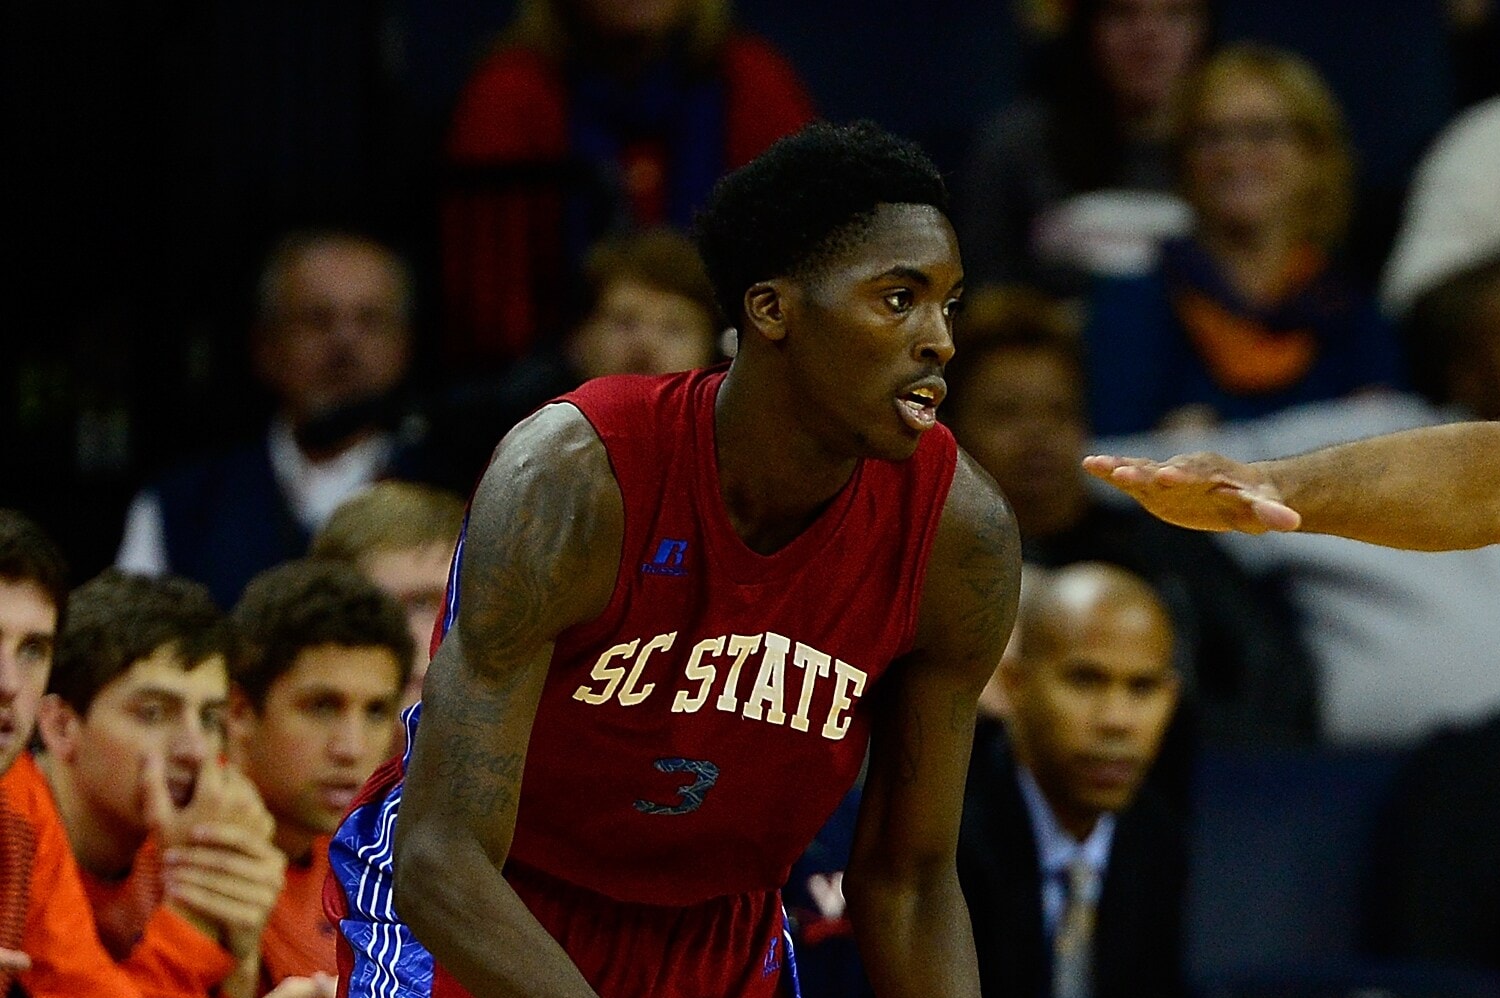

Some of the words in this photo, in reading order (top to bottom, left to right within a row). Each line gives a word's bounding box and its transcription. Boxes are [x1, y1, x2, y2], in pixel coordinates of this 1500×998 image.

[572, 631, 678, 706] SC
[671, 631, 868, 740] STATE
[632, 758, 720, 815] 3
